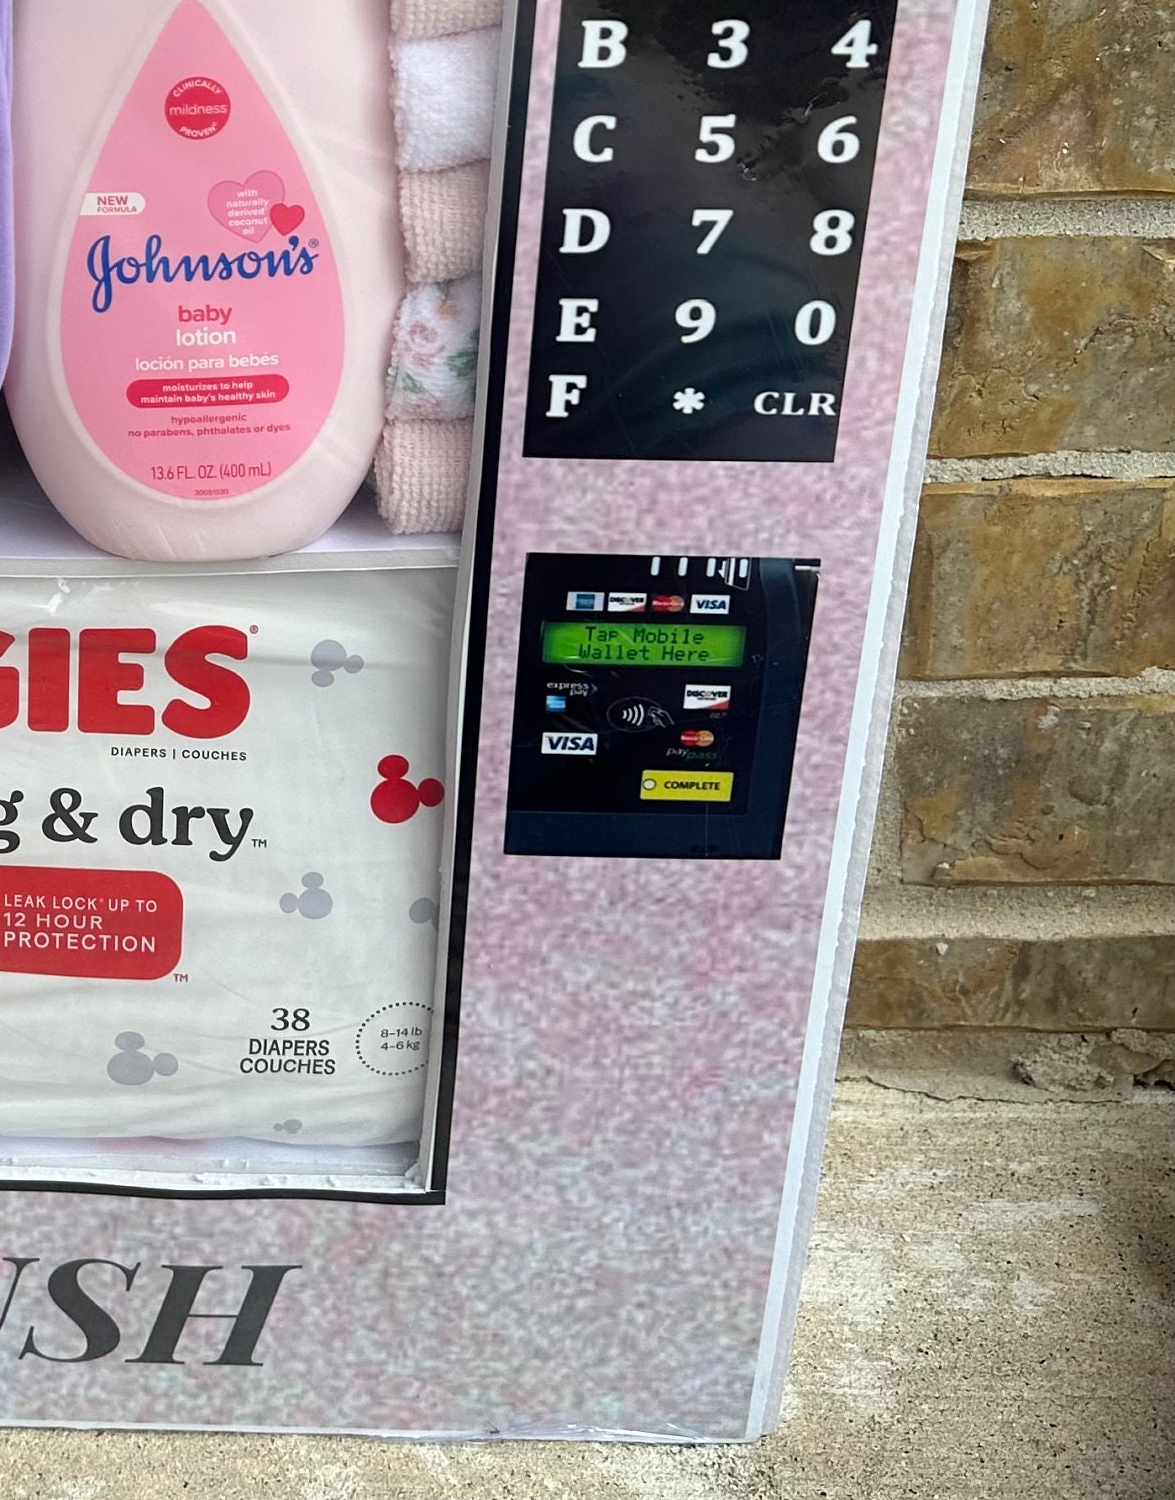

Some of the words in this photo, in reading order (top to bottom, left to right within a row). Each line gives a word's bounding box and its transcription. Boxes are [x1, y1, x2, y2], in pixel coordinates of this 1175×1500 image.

[577, 19, 629, 69] B
[707, 19, 751, 69] 3
[830, 19, 878, 69] 4
[172, 79, 222, 98] CLINICALLY
[169, 103, 227, 116] mildness
[573, 114, 617, 163] C
[694, 113, 737, 163] 5
[817, 116, 860, 164] 6
[97, 195, 129, 206] NEW
[236, 188, 258, 198] with
[97, 206, 138, 214] FORMULA
[226, 197, 270, 209] naturally
[228, 217, 268, 227] coconut
[242, 226, 255, 236] oil
[558, 208, 611, 254] D
[691, 209, 734, 255] 7
[809, 209, 855, 256] 8
[87, 234, 319, 313] Johnson's
[178, 304, 233, 326] baby
[555, 298, 599, 342] E
[674, 299, 716, 344] 9
[794, 300, 837, 345] 0
[175, 327, 237, 347] lotion
[135, 355, 184, 371] loción
[187, 357, 224, 373] para
[228, 351, 280, 369] bebés
[162, 382, 218, 392] moisturizes
[219, 382, 230, 391] to
[231, 380, 254, 391] help
[140, 394, 182, 404] maintain
[184, 393, 216, 404] baby's
[218, 391, 254, 402] healthy
[255, 389, 275, 400] skin
[545, 374, 588, 418] F
[753, 392, 837, 416] CLR
[171, 414, 247, 426] hypoallergenic
[143, 427, 195, 439] parabens,
[197, 424, 252, 437] phthalates
[253, 425, 265, 433] or
[267, 422, 291, 435] dyes
[150, 466, 174, 480] 13.6
[219, 463, 246, 480] (400
[248, 461, 272, 479] mL)
[695, 599, 727, 610] VISA
[633, 628, 705, 645] Mobile
[578, 644, 650, 660] Wallet
[662, 646, 710, 662] Here
[546, 682, 590, 693] express
[547, 736, 595, 751] VISA
[110, 746, 167, 759] DIAPERS
[181, 749, 248, 761] COUCHES
[663, 780, 721, 792] COMPLETE
[41, 787, 98, 844] &
[119, 786, 255, 862] dry
[4, 894, 46, 908] LEAK
[108, 898, 130, 912] UP
[135, 899, 158, 913] TO
[3, 912, 26, 927] 12
[36, 913, 103, 930] HOUR
[3, 931, 156, 953] PROTECTION
[270, 1007, 311, 1032] 38
[410, 1026, 423, 1037] lb
[248, 1038, 330, 1056] DIAPERS
[406, 1040, 420, 1051] kg
[239, 1057, 336, 1075] COUCHES
